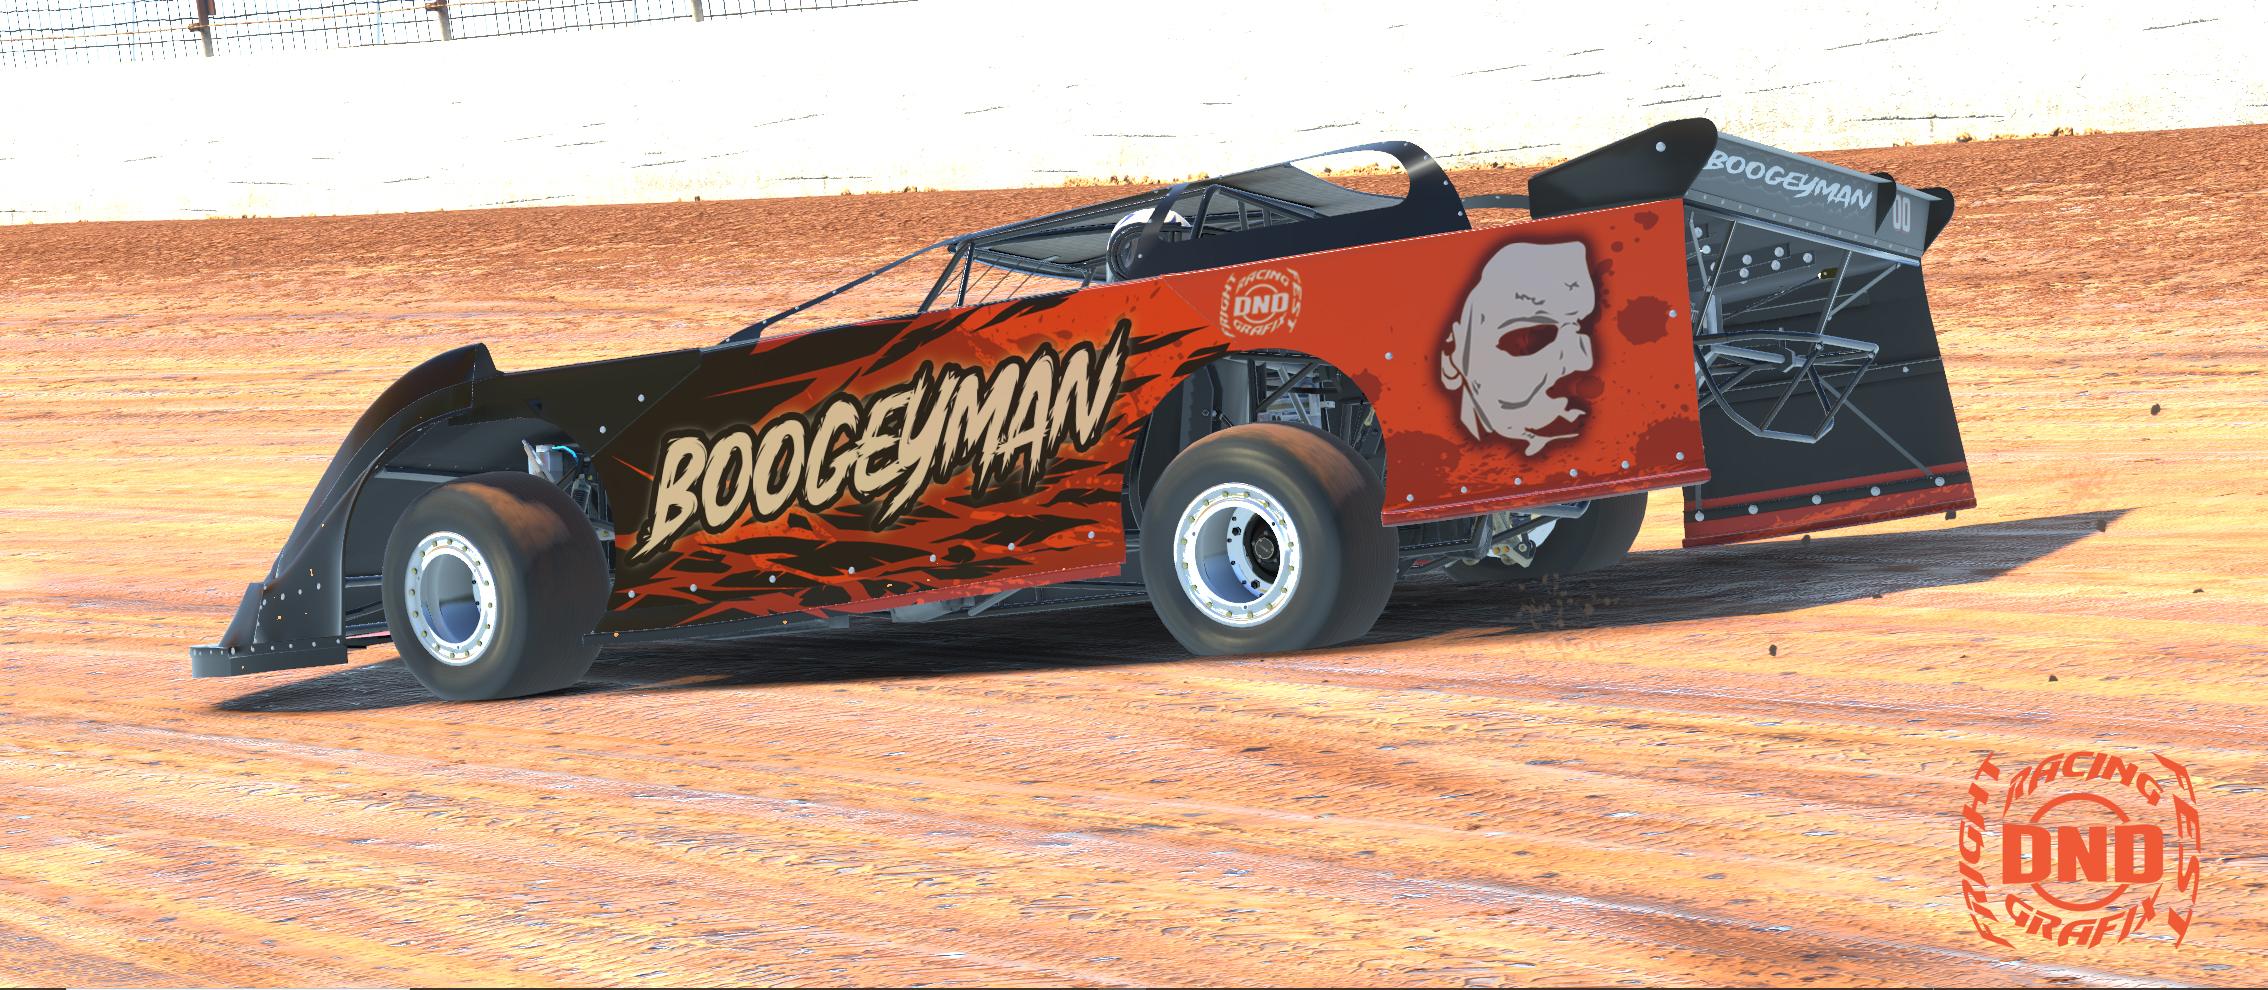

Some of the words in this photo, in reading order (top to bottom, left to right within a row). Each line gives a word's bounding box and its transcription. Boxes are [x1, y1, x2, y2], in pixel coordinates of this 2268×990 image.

[1703, 150, 1872, 209] BOOGEYMAN
[1219, 274, 1236, 338] FRIGHT
[1233, 292, 1289, 316] DND
[1236, 269, 1290, 294] RACING
[1287, 268, 1302, 333] FEST
[1233, 313, 1287, 336] GRAFIX
[632, 331, 1123, 560] BOOGEYMAN
